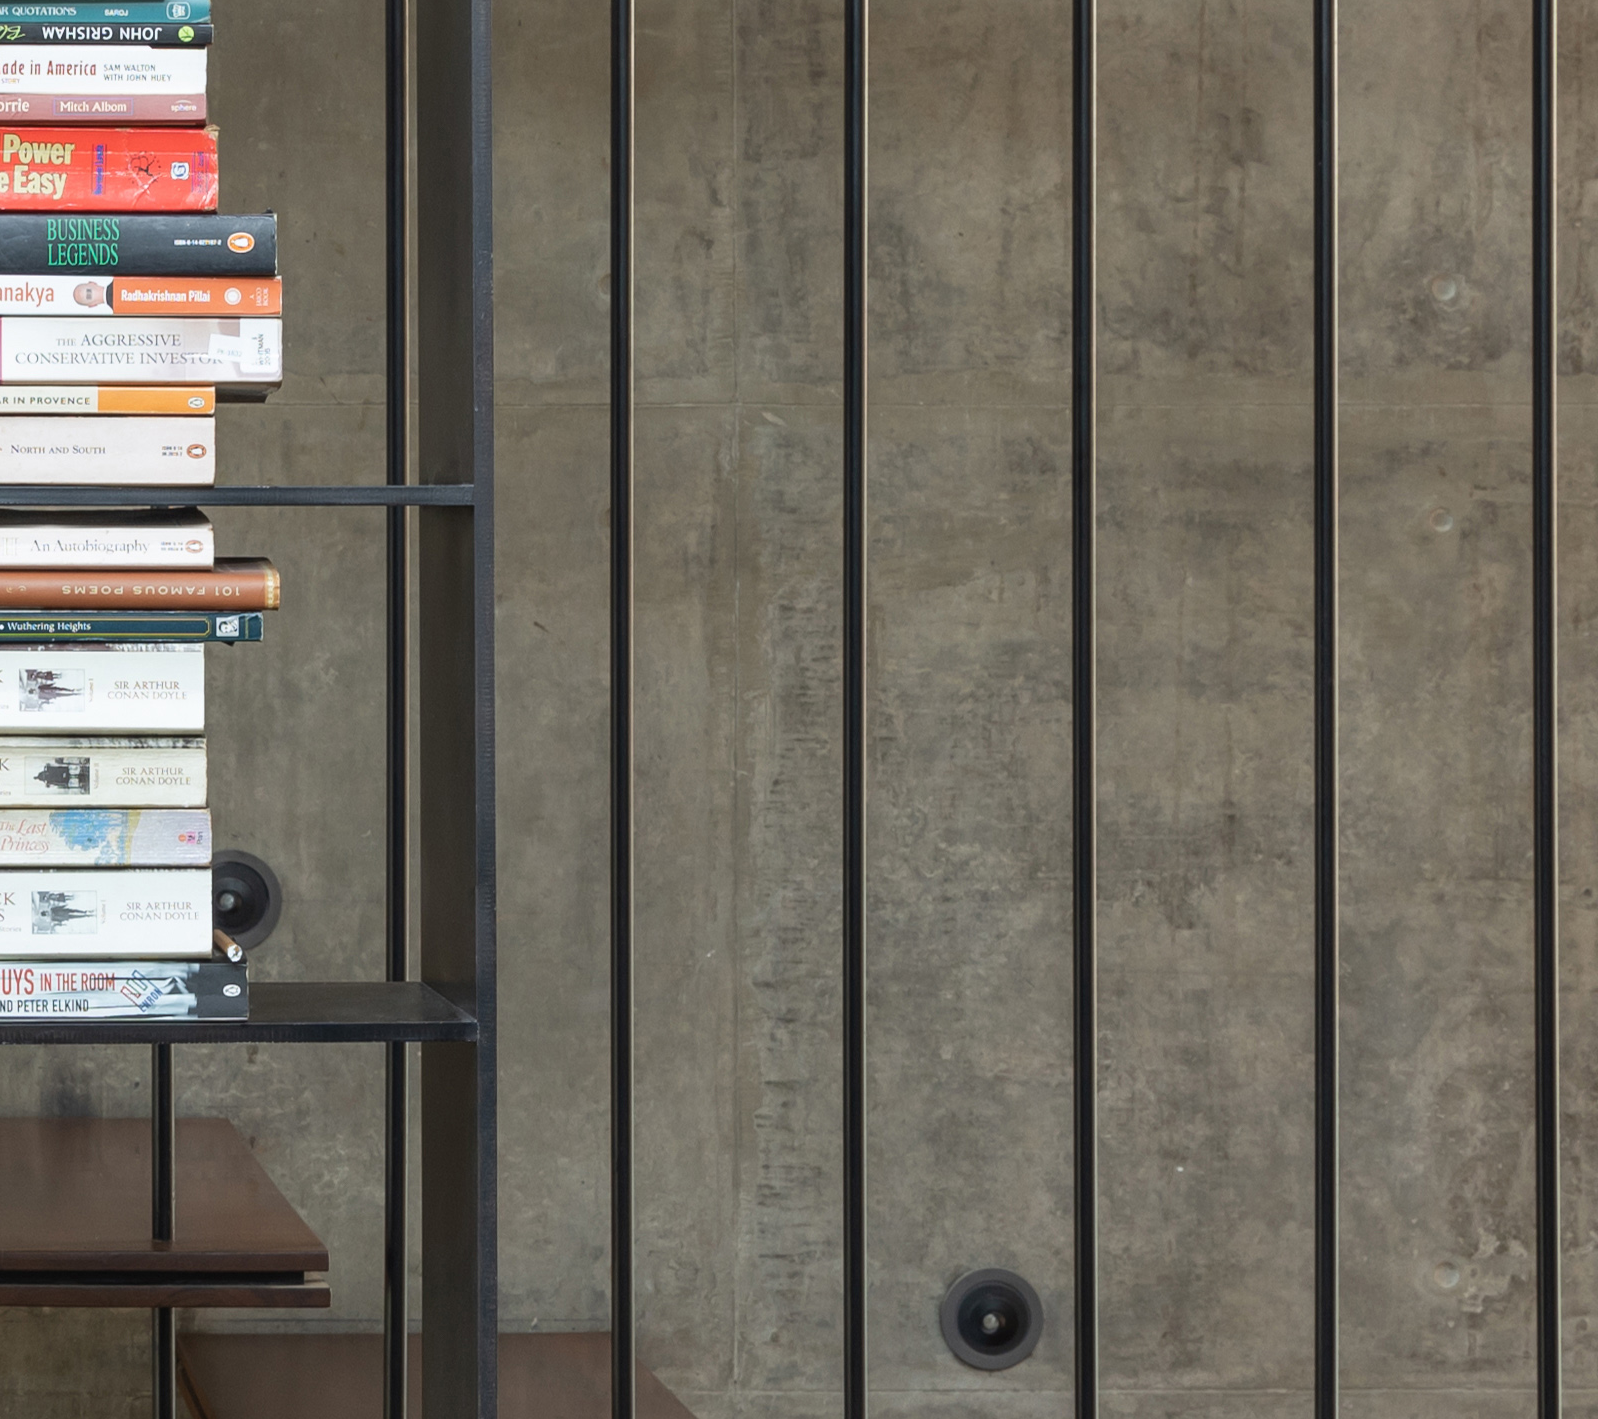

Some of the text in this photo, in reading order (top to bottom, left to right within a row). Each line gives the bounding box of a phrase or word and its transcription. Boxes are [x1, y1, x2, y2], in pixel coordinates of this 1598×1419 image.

[3, 133, 75, 165] Power
[14, 166, 67, 199] Easy
[47, 220, 119, 241] BUSINESS
[48, 243, 118, 266] LEGENDS
